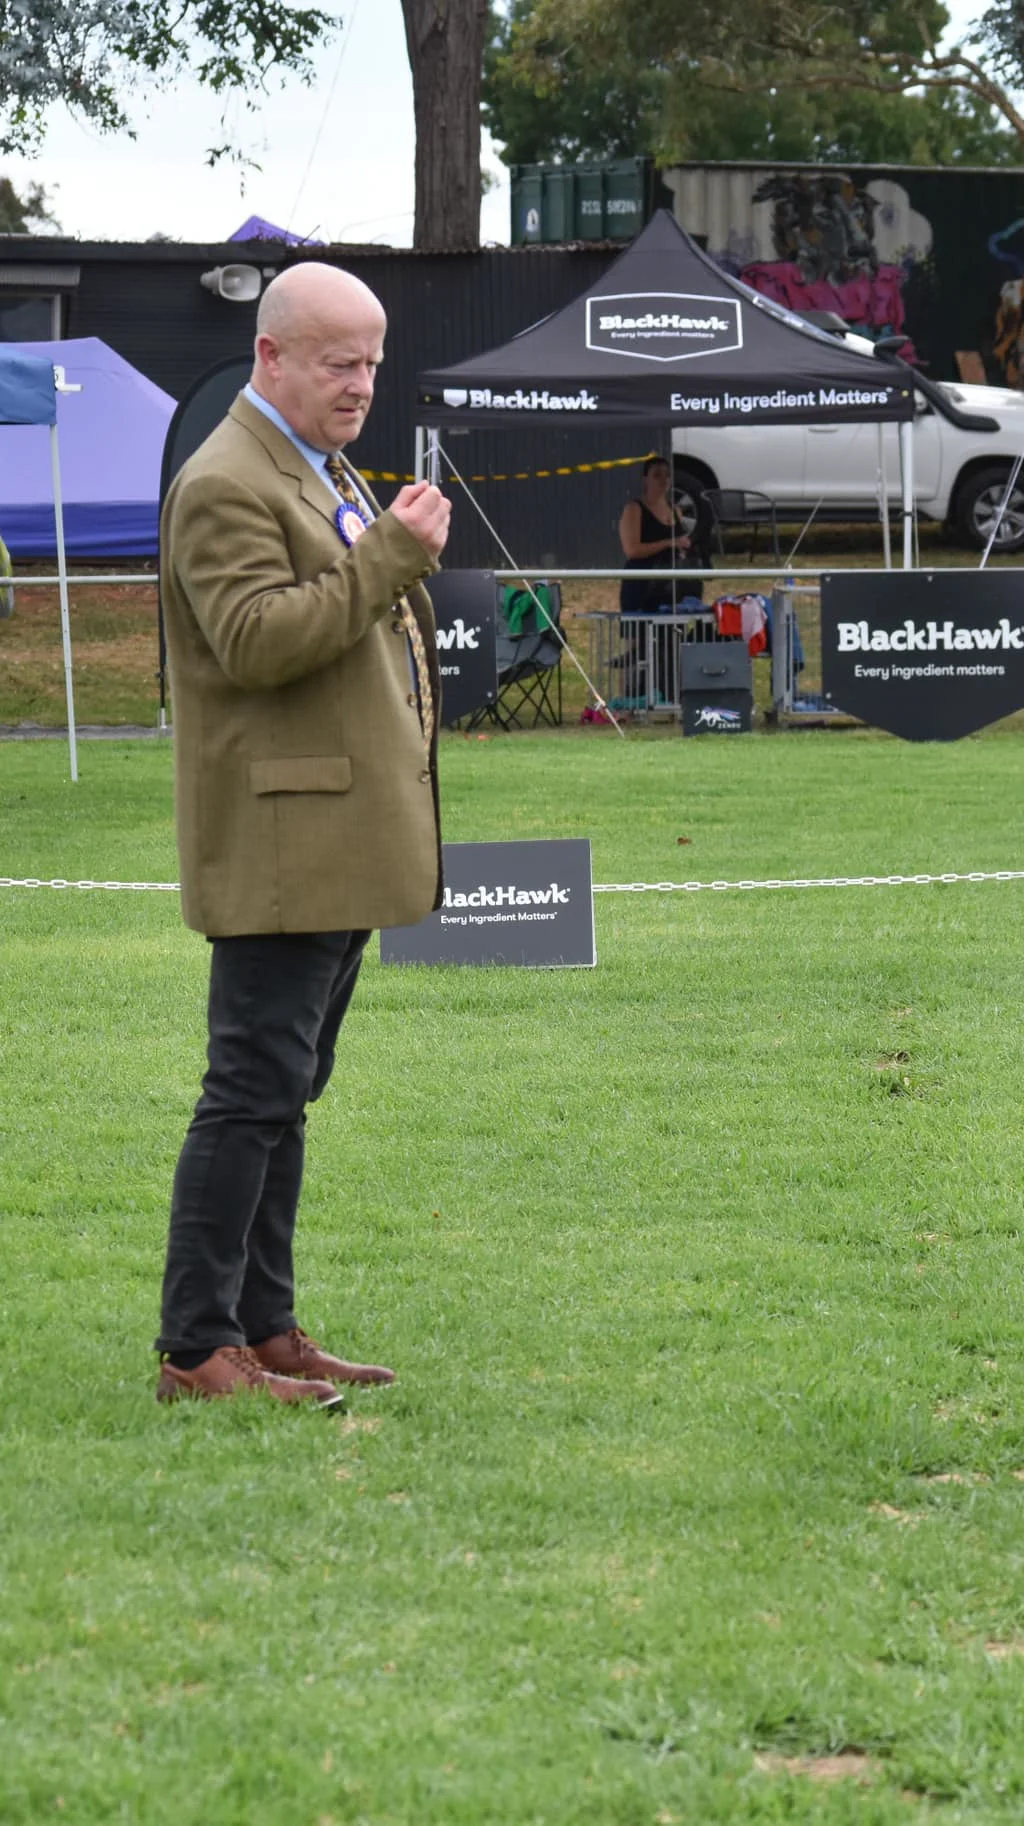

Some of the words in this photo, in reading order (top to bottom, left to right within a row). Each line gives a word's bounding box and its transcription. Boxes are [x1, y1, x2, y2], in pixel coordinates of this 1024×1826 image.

[599, 313, 729, 330] BlackHawk
[611, 331, 636, 339] Every
[469, 388, 598, 410] BlackHawk
[670, 393, 721, 413] Every
[723, 390, 816, 413] Ingredient
[819, 388, 888, 405] Matters
[837, 618, 1024, 651] BlackHawk
[854, 664, 890, 680] Every
[891, 663, 955, 680] ingredient
[956, 664, 1006, 676] matters
[441, 883, 569, 908] lackHawk
[440, 914, 468, 926] Every
[468, 912, 517, 925] Ingredient
[517, 912, 556, 921] Matters
